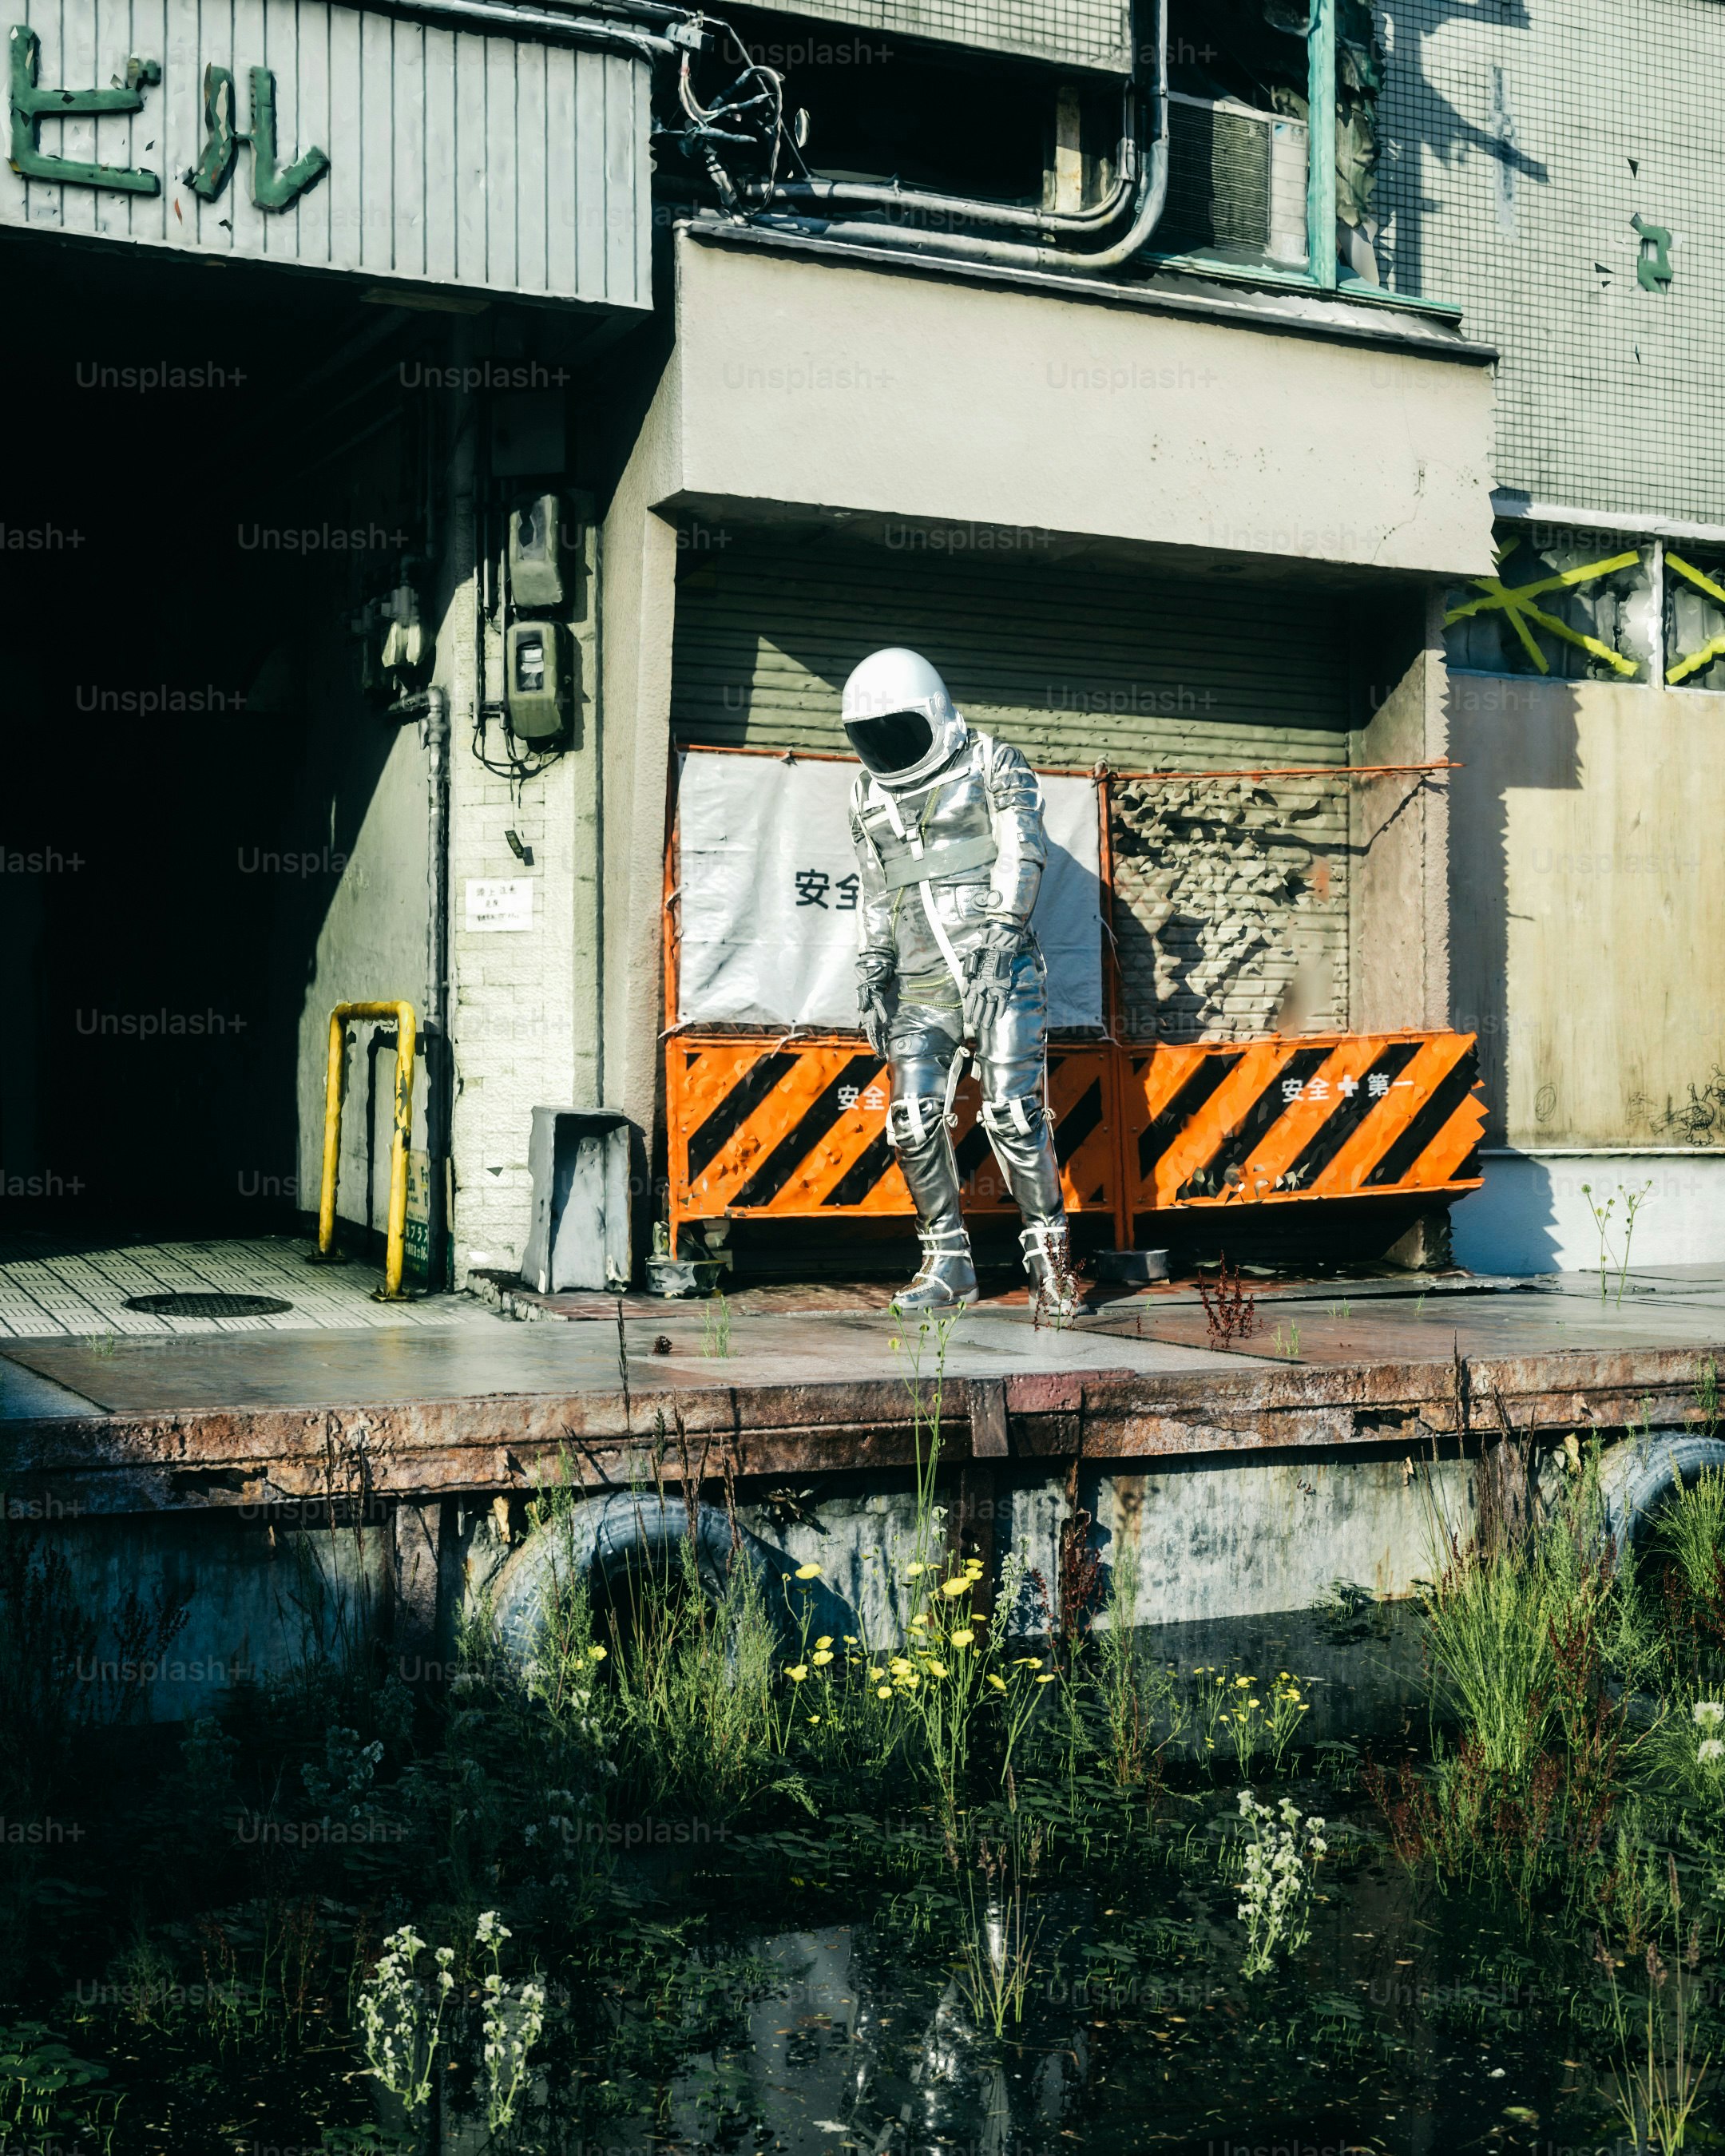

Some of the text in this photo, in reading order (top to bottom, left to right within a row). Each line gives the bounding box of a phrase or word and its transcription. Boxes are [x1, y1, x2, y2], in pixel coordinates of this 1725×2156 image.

[10, 25, 331, 214] ビル
[795, 868, 860, 910] 安全
[837, 1084, 886, 1111] 安全
[1281, 1072, 1414, 1103] 安全 第一
